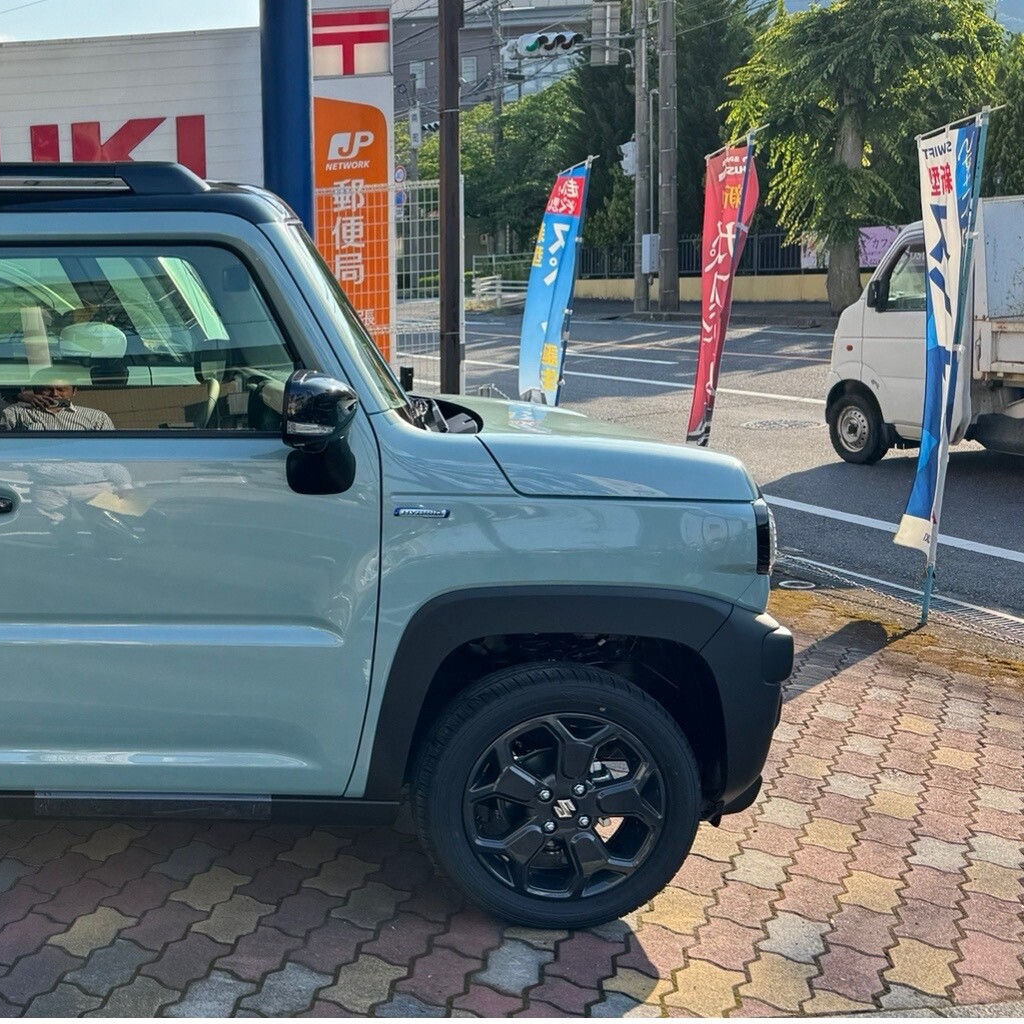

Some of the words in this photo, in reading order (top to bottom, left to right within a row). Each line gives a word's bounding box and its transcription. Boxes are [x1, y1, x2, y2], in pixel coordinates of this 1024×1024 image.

[325, 160, 370, 171] NETWORK
[332, 178, 365, 286] 郵便局
